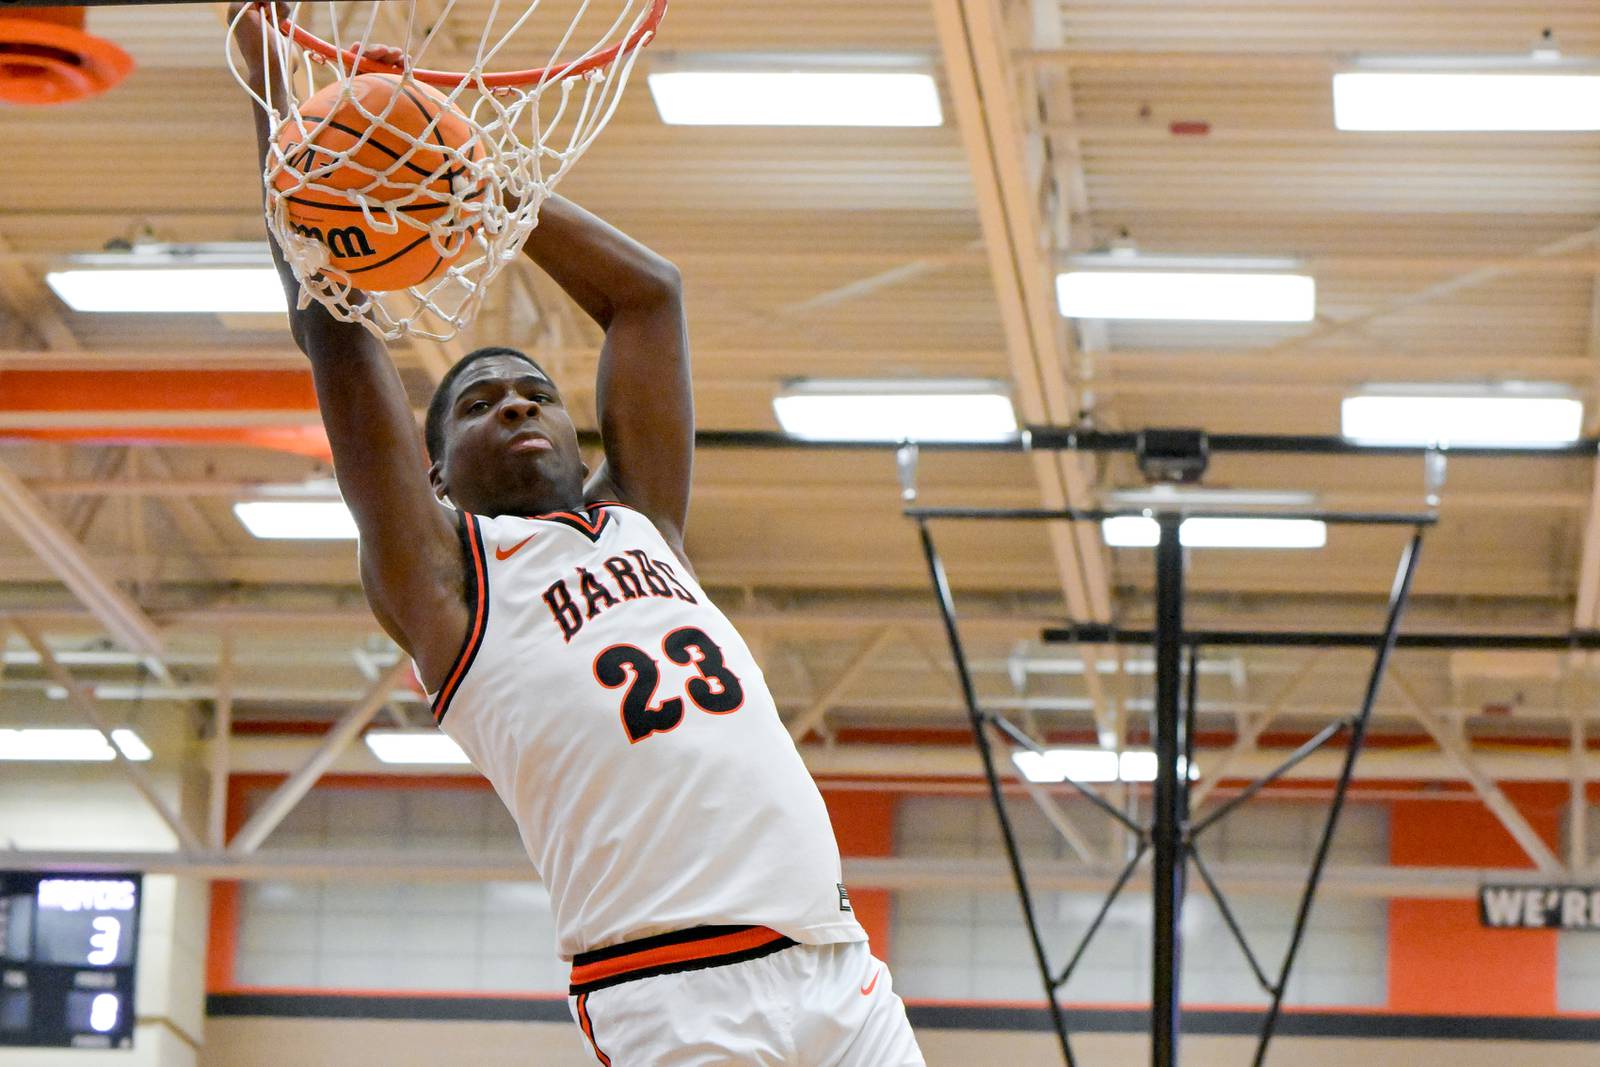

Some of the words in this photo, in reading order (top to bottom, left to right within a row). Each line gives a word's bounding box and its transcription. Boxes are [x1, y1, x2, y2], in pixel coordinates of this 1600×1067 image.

[542, 549, 698, 644] BARBS
[592, 625, 745, 744] 23
[87, 916, 120, 965] 3
